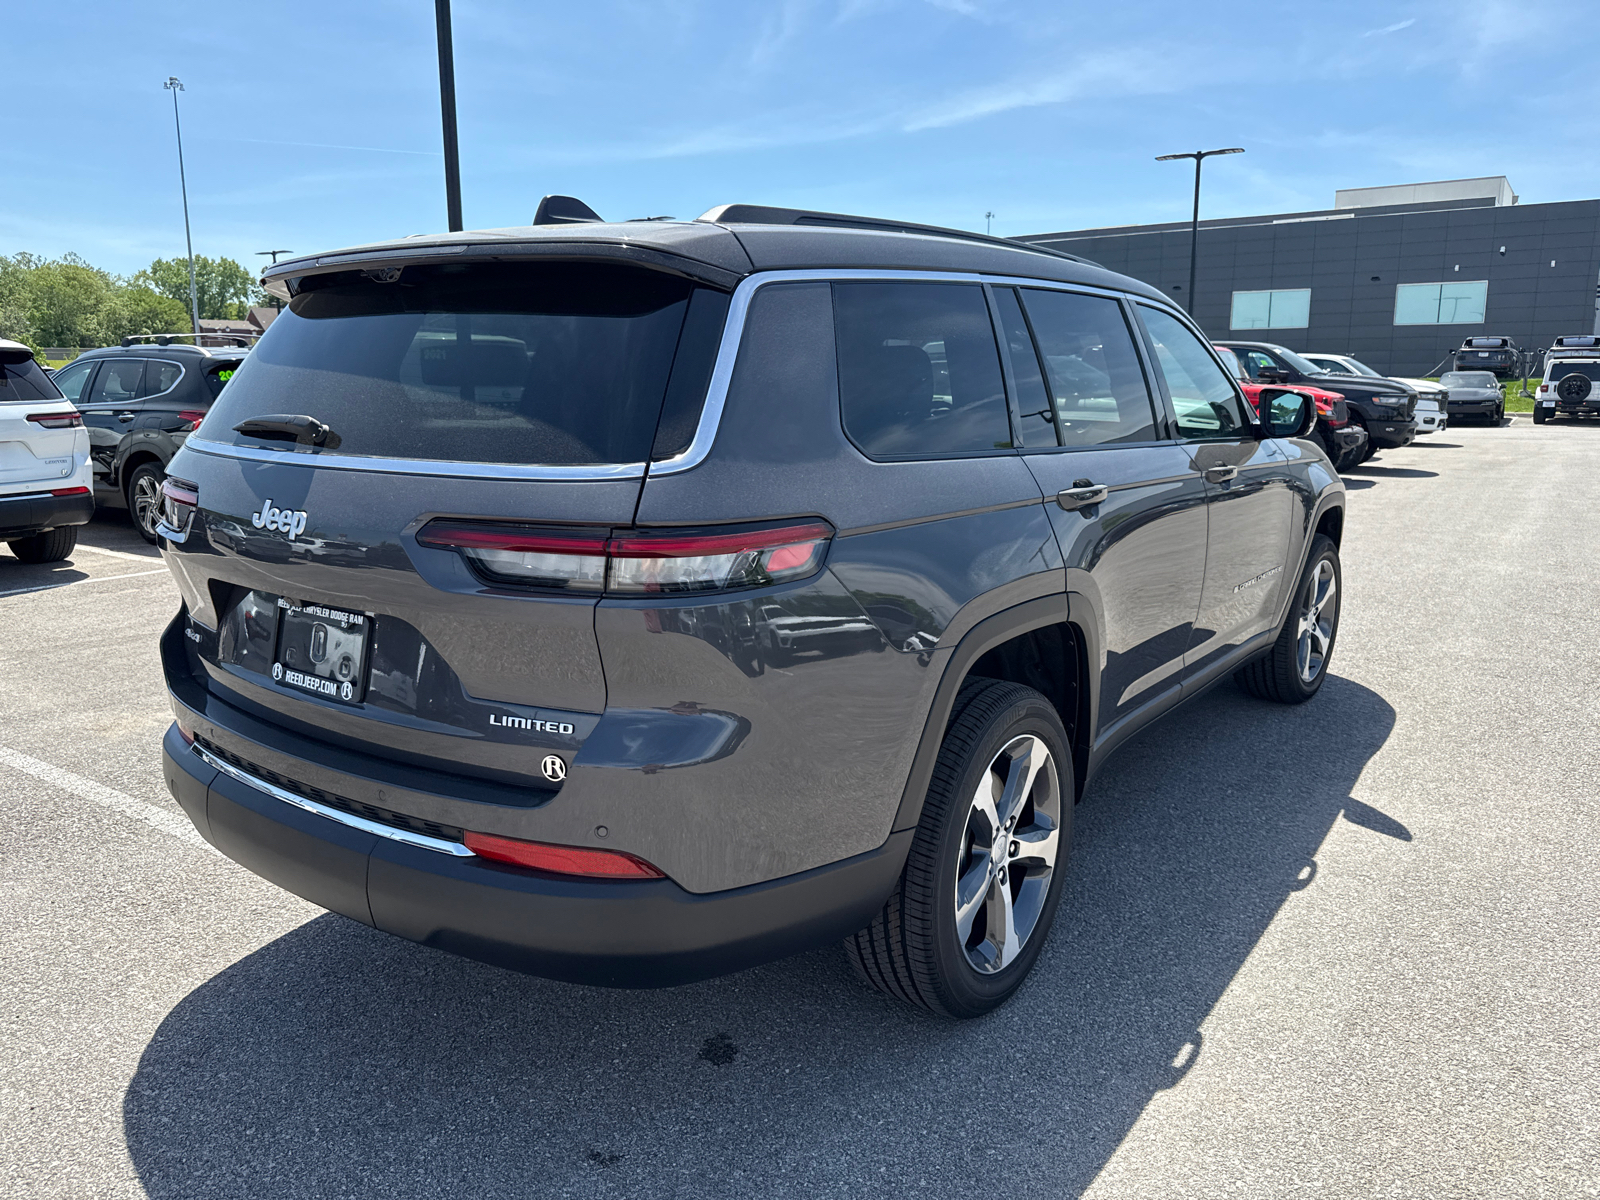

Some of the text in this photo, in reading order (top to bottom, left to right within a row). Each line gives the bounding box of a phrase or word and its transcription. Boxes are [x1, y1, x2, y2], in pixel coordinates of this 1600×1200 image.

[218, 370, 236, 382] 20
[252, 499, 308, 541] Jeep
[303, 606, 330, 618] CHRYSLER
[330, 609, 349, 622] DODGE
[349, 613, 364, 625] RAM
[285, 670, 337, 696] REEDJEEP.COM
[490, 714, 574, 734] LIMITED
[542, 756, 567, 781] R
